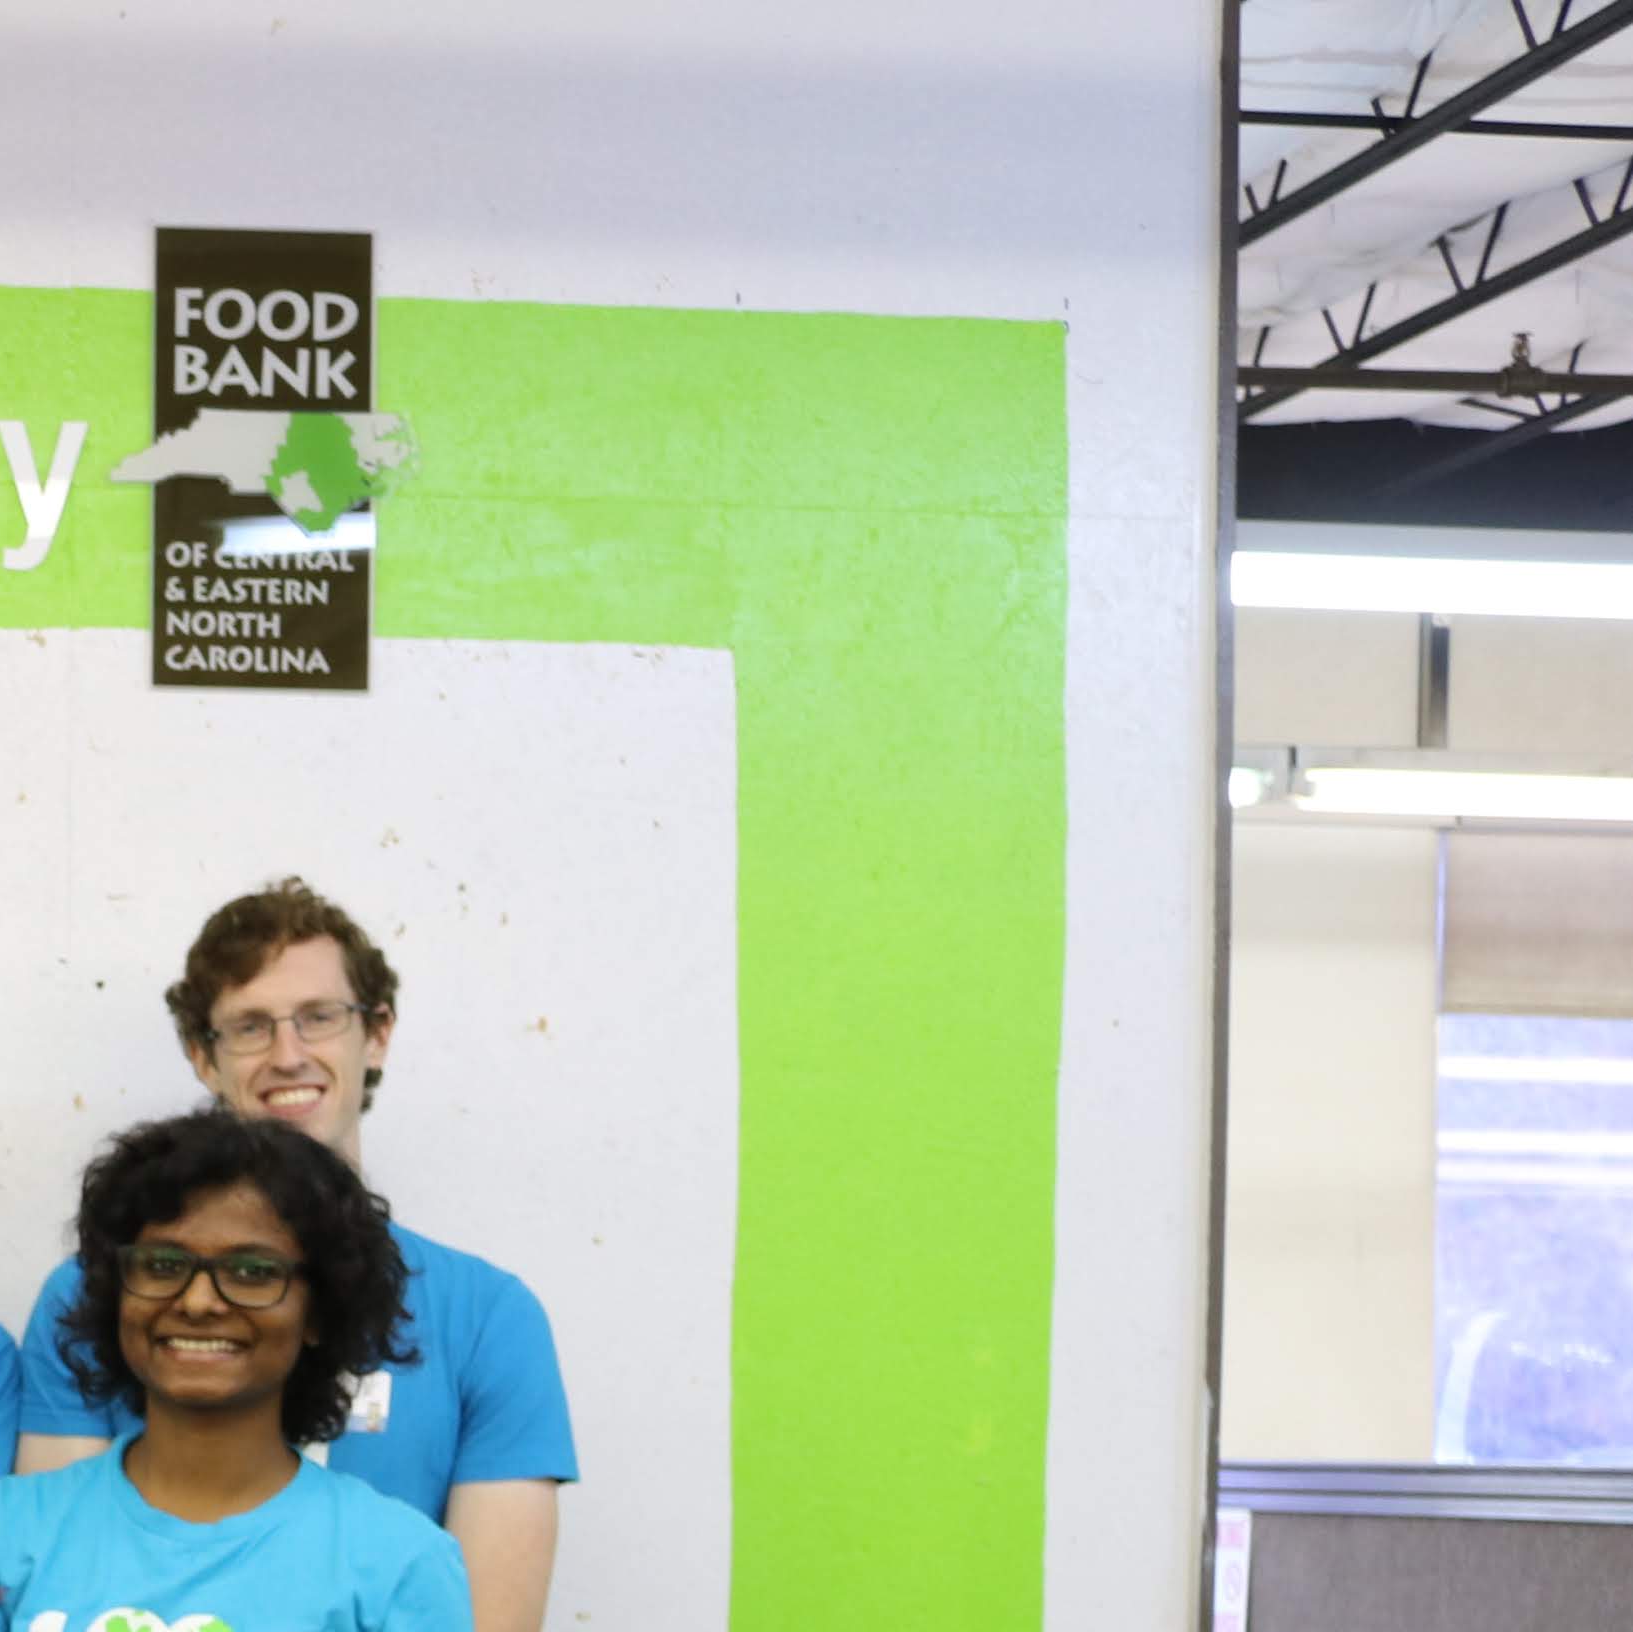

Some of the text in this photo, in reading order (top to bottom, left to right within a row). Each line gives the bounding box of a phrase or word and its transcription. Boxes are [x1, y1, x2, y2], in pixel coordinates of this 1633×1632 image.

[173, 287, 359, 342] FOOD
[173, 345, 357, 398] BANK
[165, 541, 355, 572] OF CENTRAL
[164, 576, 330, 605] & EASTERN
[166, 611, 282, 639] NORTH
[165, 646, 331, 675] CAROLINA
